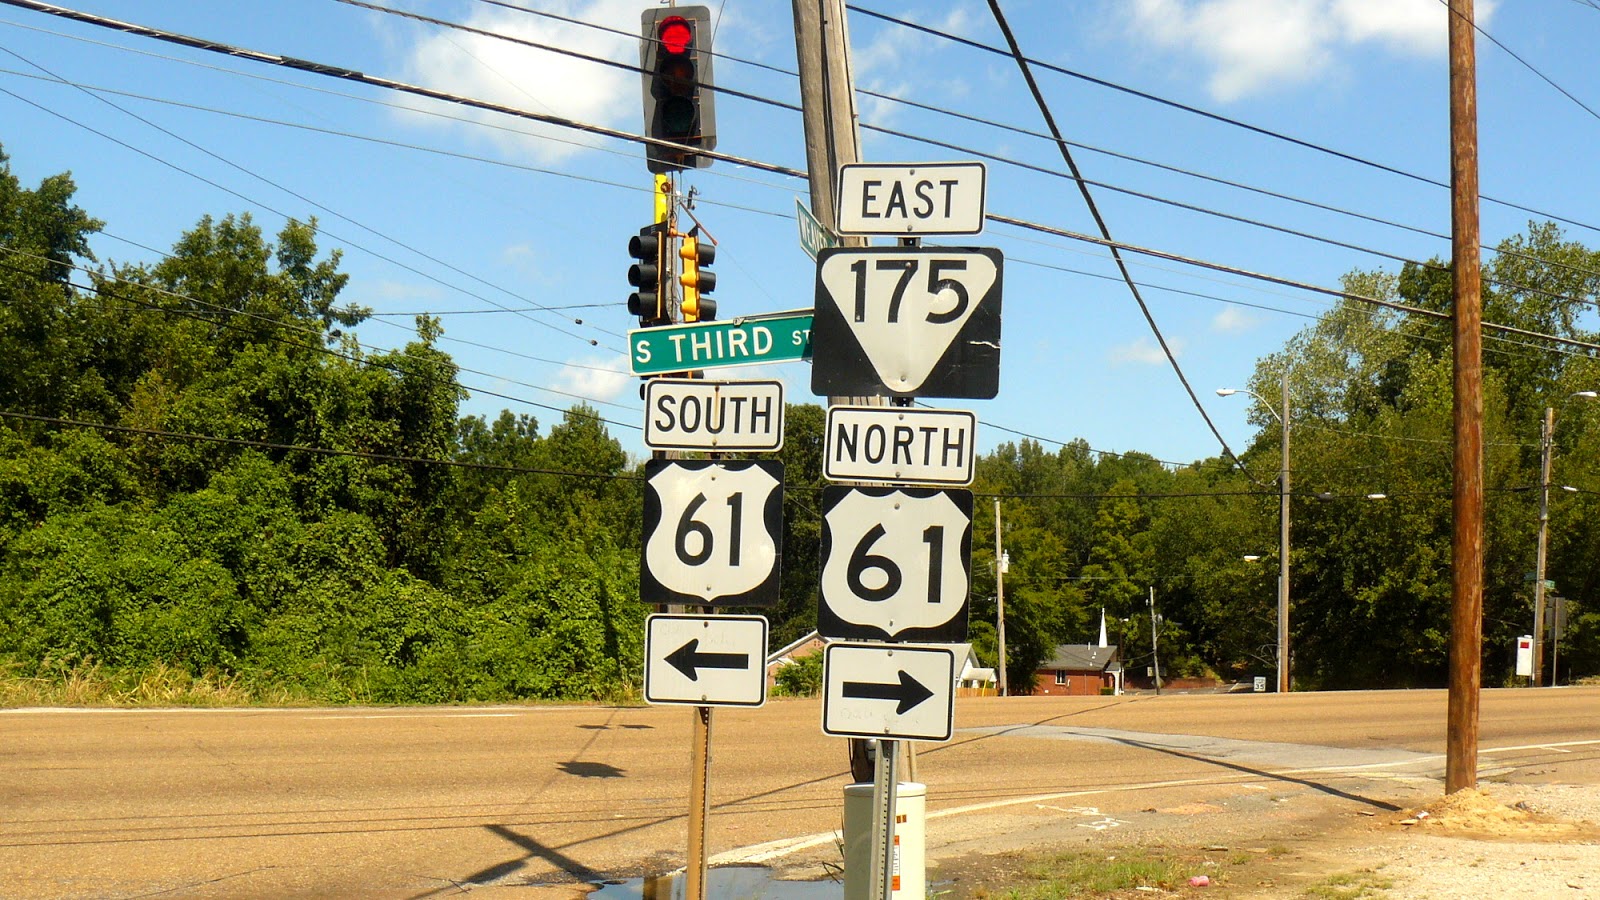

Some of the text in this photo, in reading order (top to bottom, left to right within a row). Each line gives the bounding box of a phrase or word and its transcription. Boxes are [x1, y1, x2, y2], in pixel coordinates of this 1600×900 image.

[862, 180, 959, 218] EAST
[851, 260, 969, 324] 175
[636, 339, 651, 364] S
[669, 326, 773, 363] THIRD
[655, 394, 772, 434] SOUTH
[836, 423, 965, 468] NORTH
[675, 492, 743, 567] 61
[847, 523, 944, 603] 61
